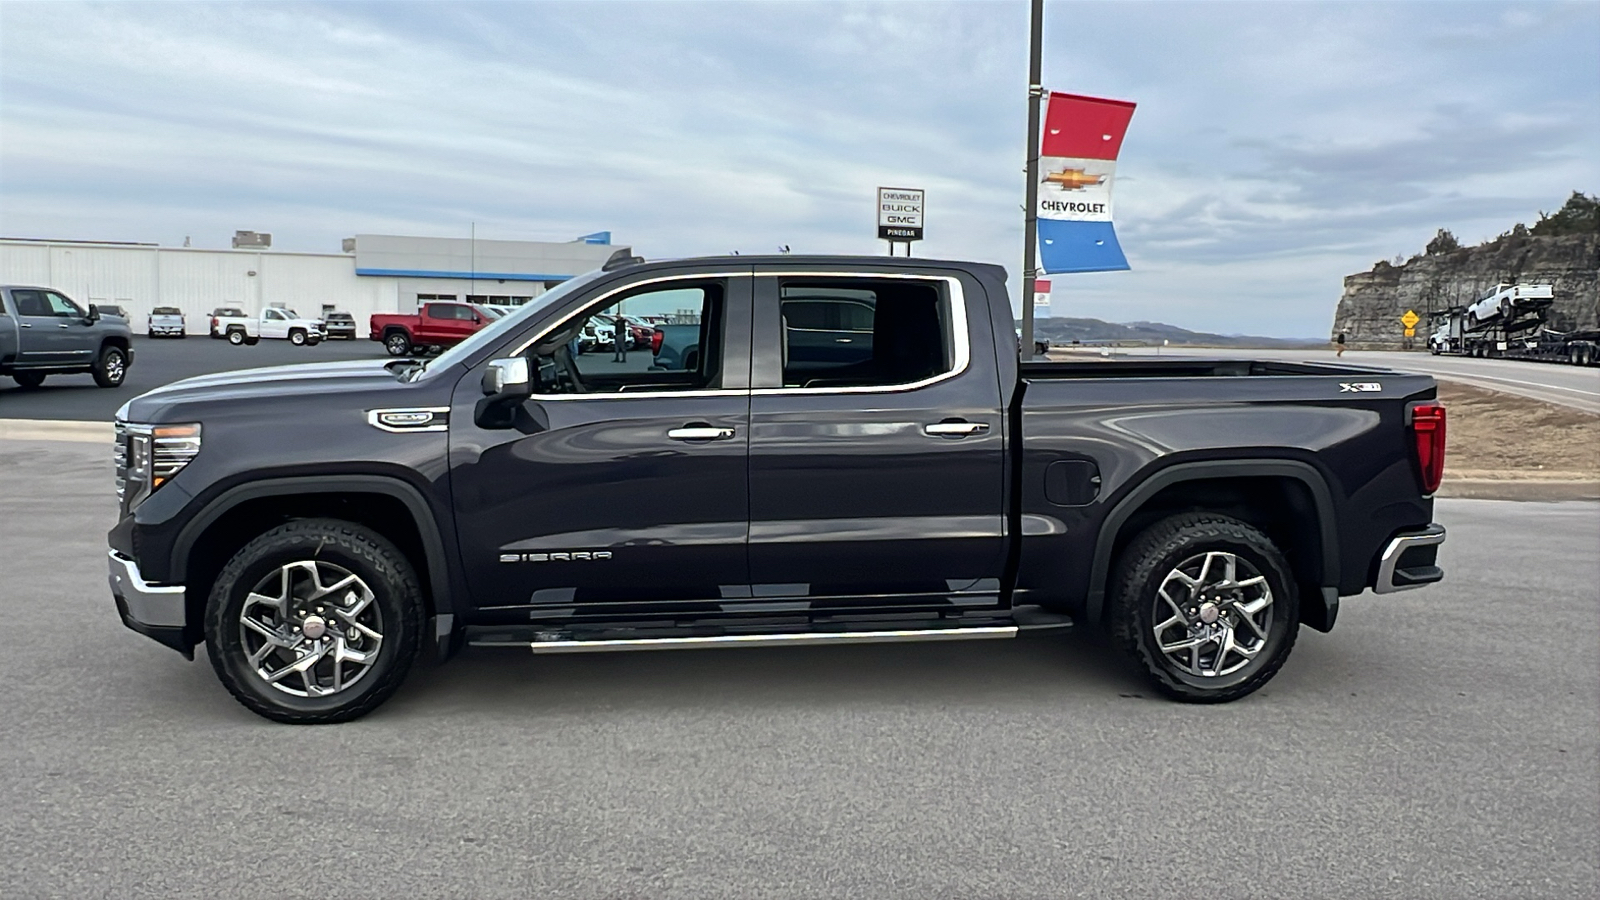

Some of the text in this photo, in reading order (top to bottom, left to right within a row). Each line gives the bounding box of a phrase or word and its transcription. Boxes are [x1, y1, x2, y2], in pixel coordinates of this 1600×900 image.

[883, 193, 921, 201] CHEVROLET
[882, 204, 920, 213] BUICK
[1041, 200, 1105, 213] CHEVROLET
[887, 216, 916, 224] GMC
[500, 551, 612, 562] SIERRA
